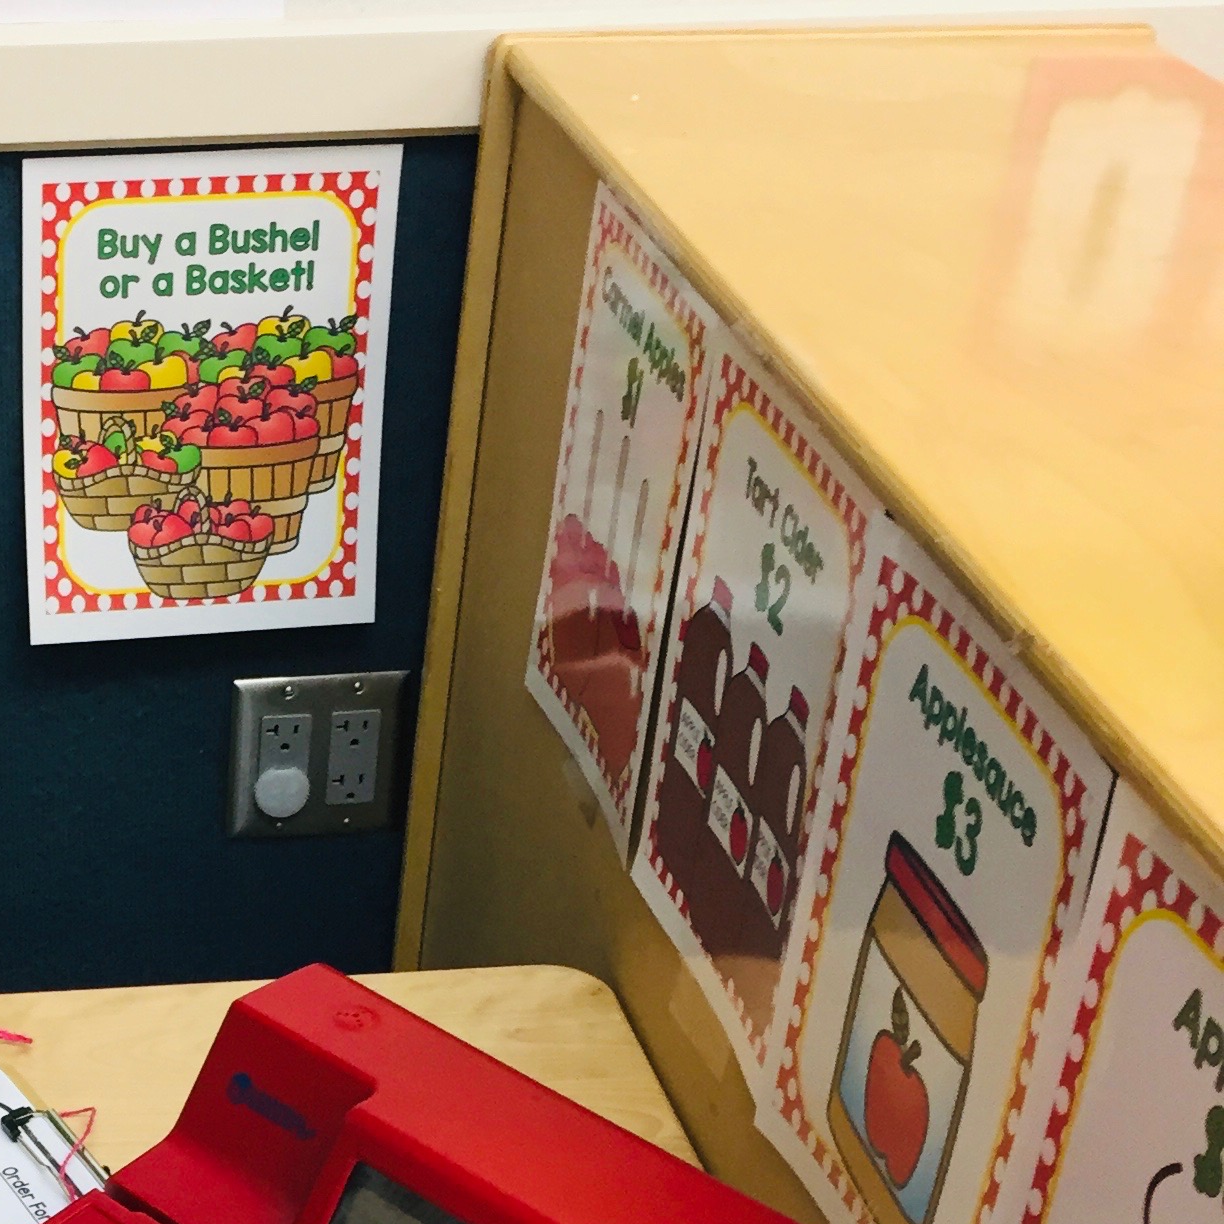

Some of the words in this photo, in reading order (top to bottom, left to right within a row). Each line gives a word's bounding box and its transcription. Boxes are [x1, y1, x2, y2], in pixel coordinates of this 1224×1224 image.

[97, 228, 163, 265] Buy
[175, 231, 197, 257] a
[208, 219, 320, 256] Bushel
[99, 274, 140, 299] or
[152, 271, 174, 297] a
[185, 259, 315, 297] Basket!
[754, 542, 792, 637] $2
[908, 663, 1038, 848] Applesauce
[935, 770, 983, 877] $3
[1, 1166, 36, 1201] Order
[28, 1201, 51, 1221] For
